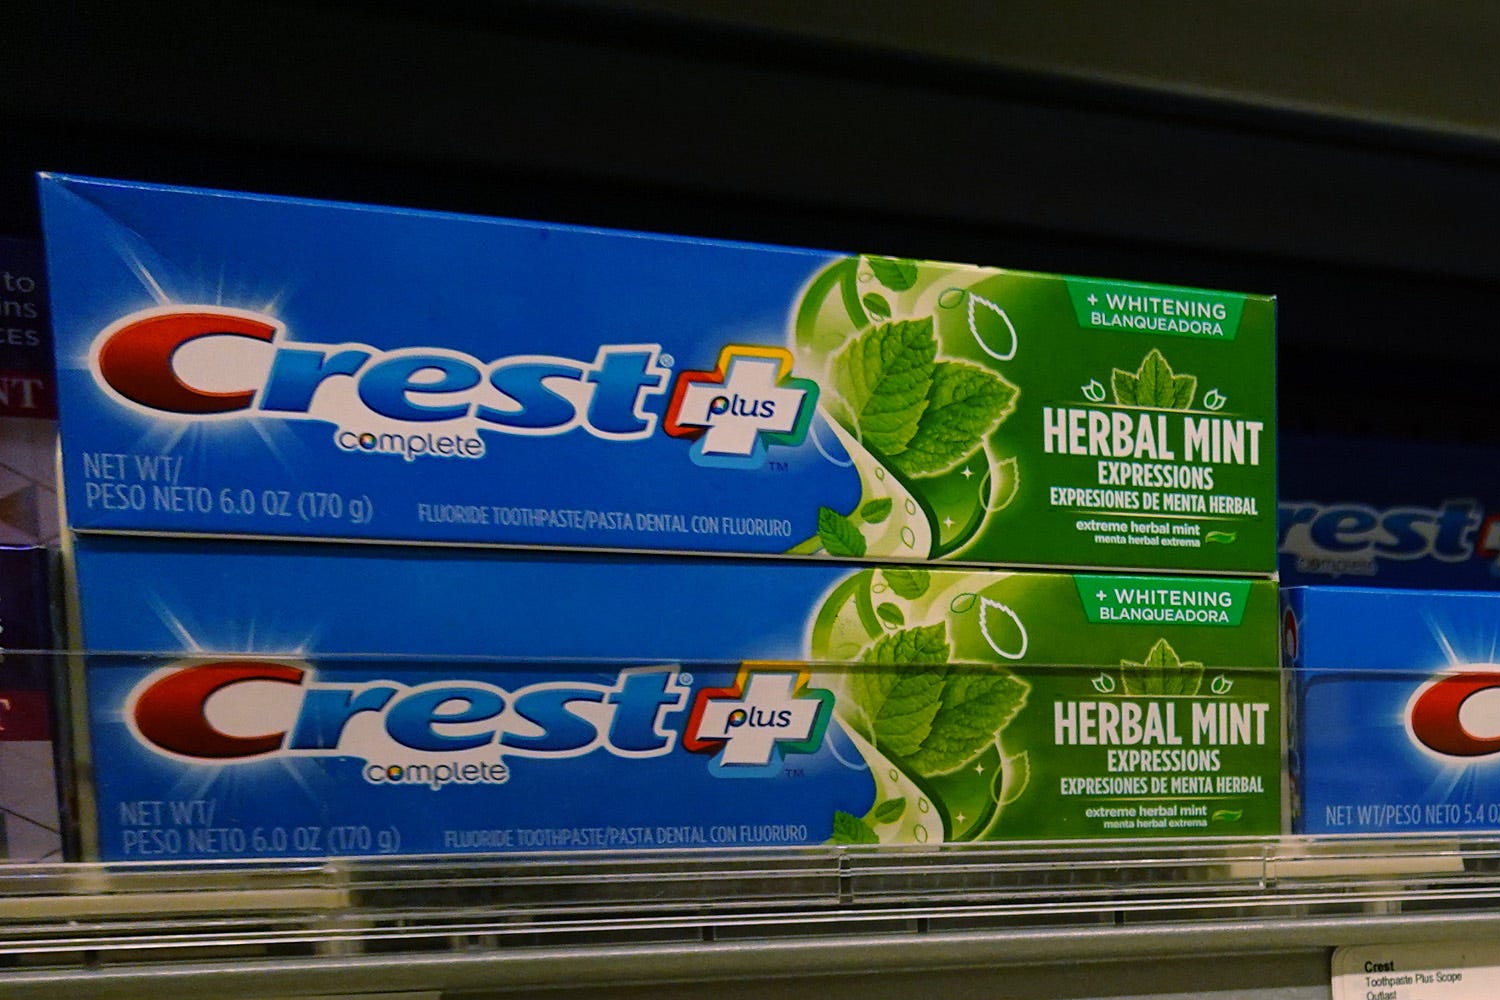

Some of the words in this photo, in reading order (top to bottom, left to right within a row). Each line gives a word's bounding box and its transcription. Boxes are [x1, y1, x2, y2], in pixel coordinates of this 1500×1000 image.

[1105, 293, 1227, 320] WHITENING
[1090, 312, 1224, 336] BLANQUEADORA
[98, 309, 661, 434] Crest
[706, 394, 777, 420] plus
[338, 429, 483, 459] complete
[1043, 406, 1175, 460] HERBAL
[1184, 416, 1264, 466] MINT
[83, 452, 128, 480] NET
[135, 455, 183, 485] WT/
[1098, 461, 1214, 490] EXPRESSIONS
[86, 482, 146, 511] PESO
[153, 486, 213, 513] NETO
[219, 488, 256, 515] 6.0
[262, 491, 292, 517] OZ
[300, 491, 342, 521] (170
[350, 495, 373, 524] g)
[1050, 486, 1140, 511] EXPRESIONES
[1143, 492, 1160, 511] DE
[1163, 493, 1207, 514] MENTA
[1209, 496, 1258, 516] HERBAL
[418, 503, 490, 526] FLUORIDE
[492, 507, 634, 532] TOOTHPASTE/PASTA
[636, 512, 687, 535] DENTAL
[691, 514, 720, 535] CON
[721, 516, 792, 538] FLUORURO
[1076, 519, 1128, 532] extreme
[1130, 520, 1170, 534] herbal
[1173, 523, 1200, 536] mint
[1094, 533, 1127, 545] menta
[1128, 534, 1160, 546] herbal
[1161, 537, 1201, 548] extrema
[1113, 588, 1232, 607] WHITENING
[1099, 607, 1230, 623] BLANQUEADORA
[132, 658, 682, 759] Crest
[724, 704, 792, 732] plus
[1054, 701, 1182, 746] HERBAL
[1192, 702, 1270, 746] MINT
[367, 760, 509, 788] complete
[1107, 749, 1221, 772] EXPRESSIONS
[1060, 777, 1148, 795] EXPRESIONES
[1151, 776, 1168, 794] DE
[1171, 776, 1213, 795] MENTA
[1216, 775, 1264, 794] HERBAL
[1085, 805, 1136, 818] extreme
[1138, 804, 1178, 818] herbal
[1180, 804, 1207, 817] mint
[1325, 805, 1353, 826] NET
[1357, 804, 1421, 827] WT/PESO
[1425, 803, 1461, 825] NETO
[1463, 803, 1485, 825] 5.4
[1364, 960, 1395, 973] Crest
[1366, 974, 1413, 989] Toothpaste
[1415, 973, 1434, 985] Plus
[1436, 971, 1463, 983] Scope
